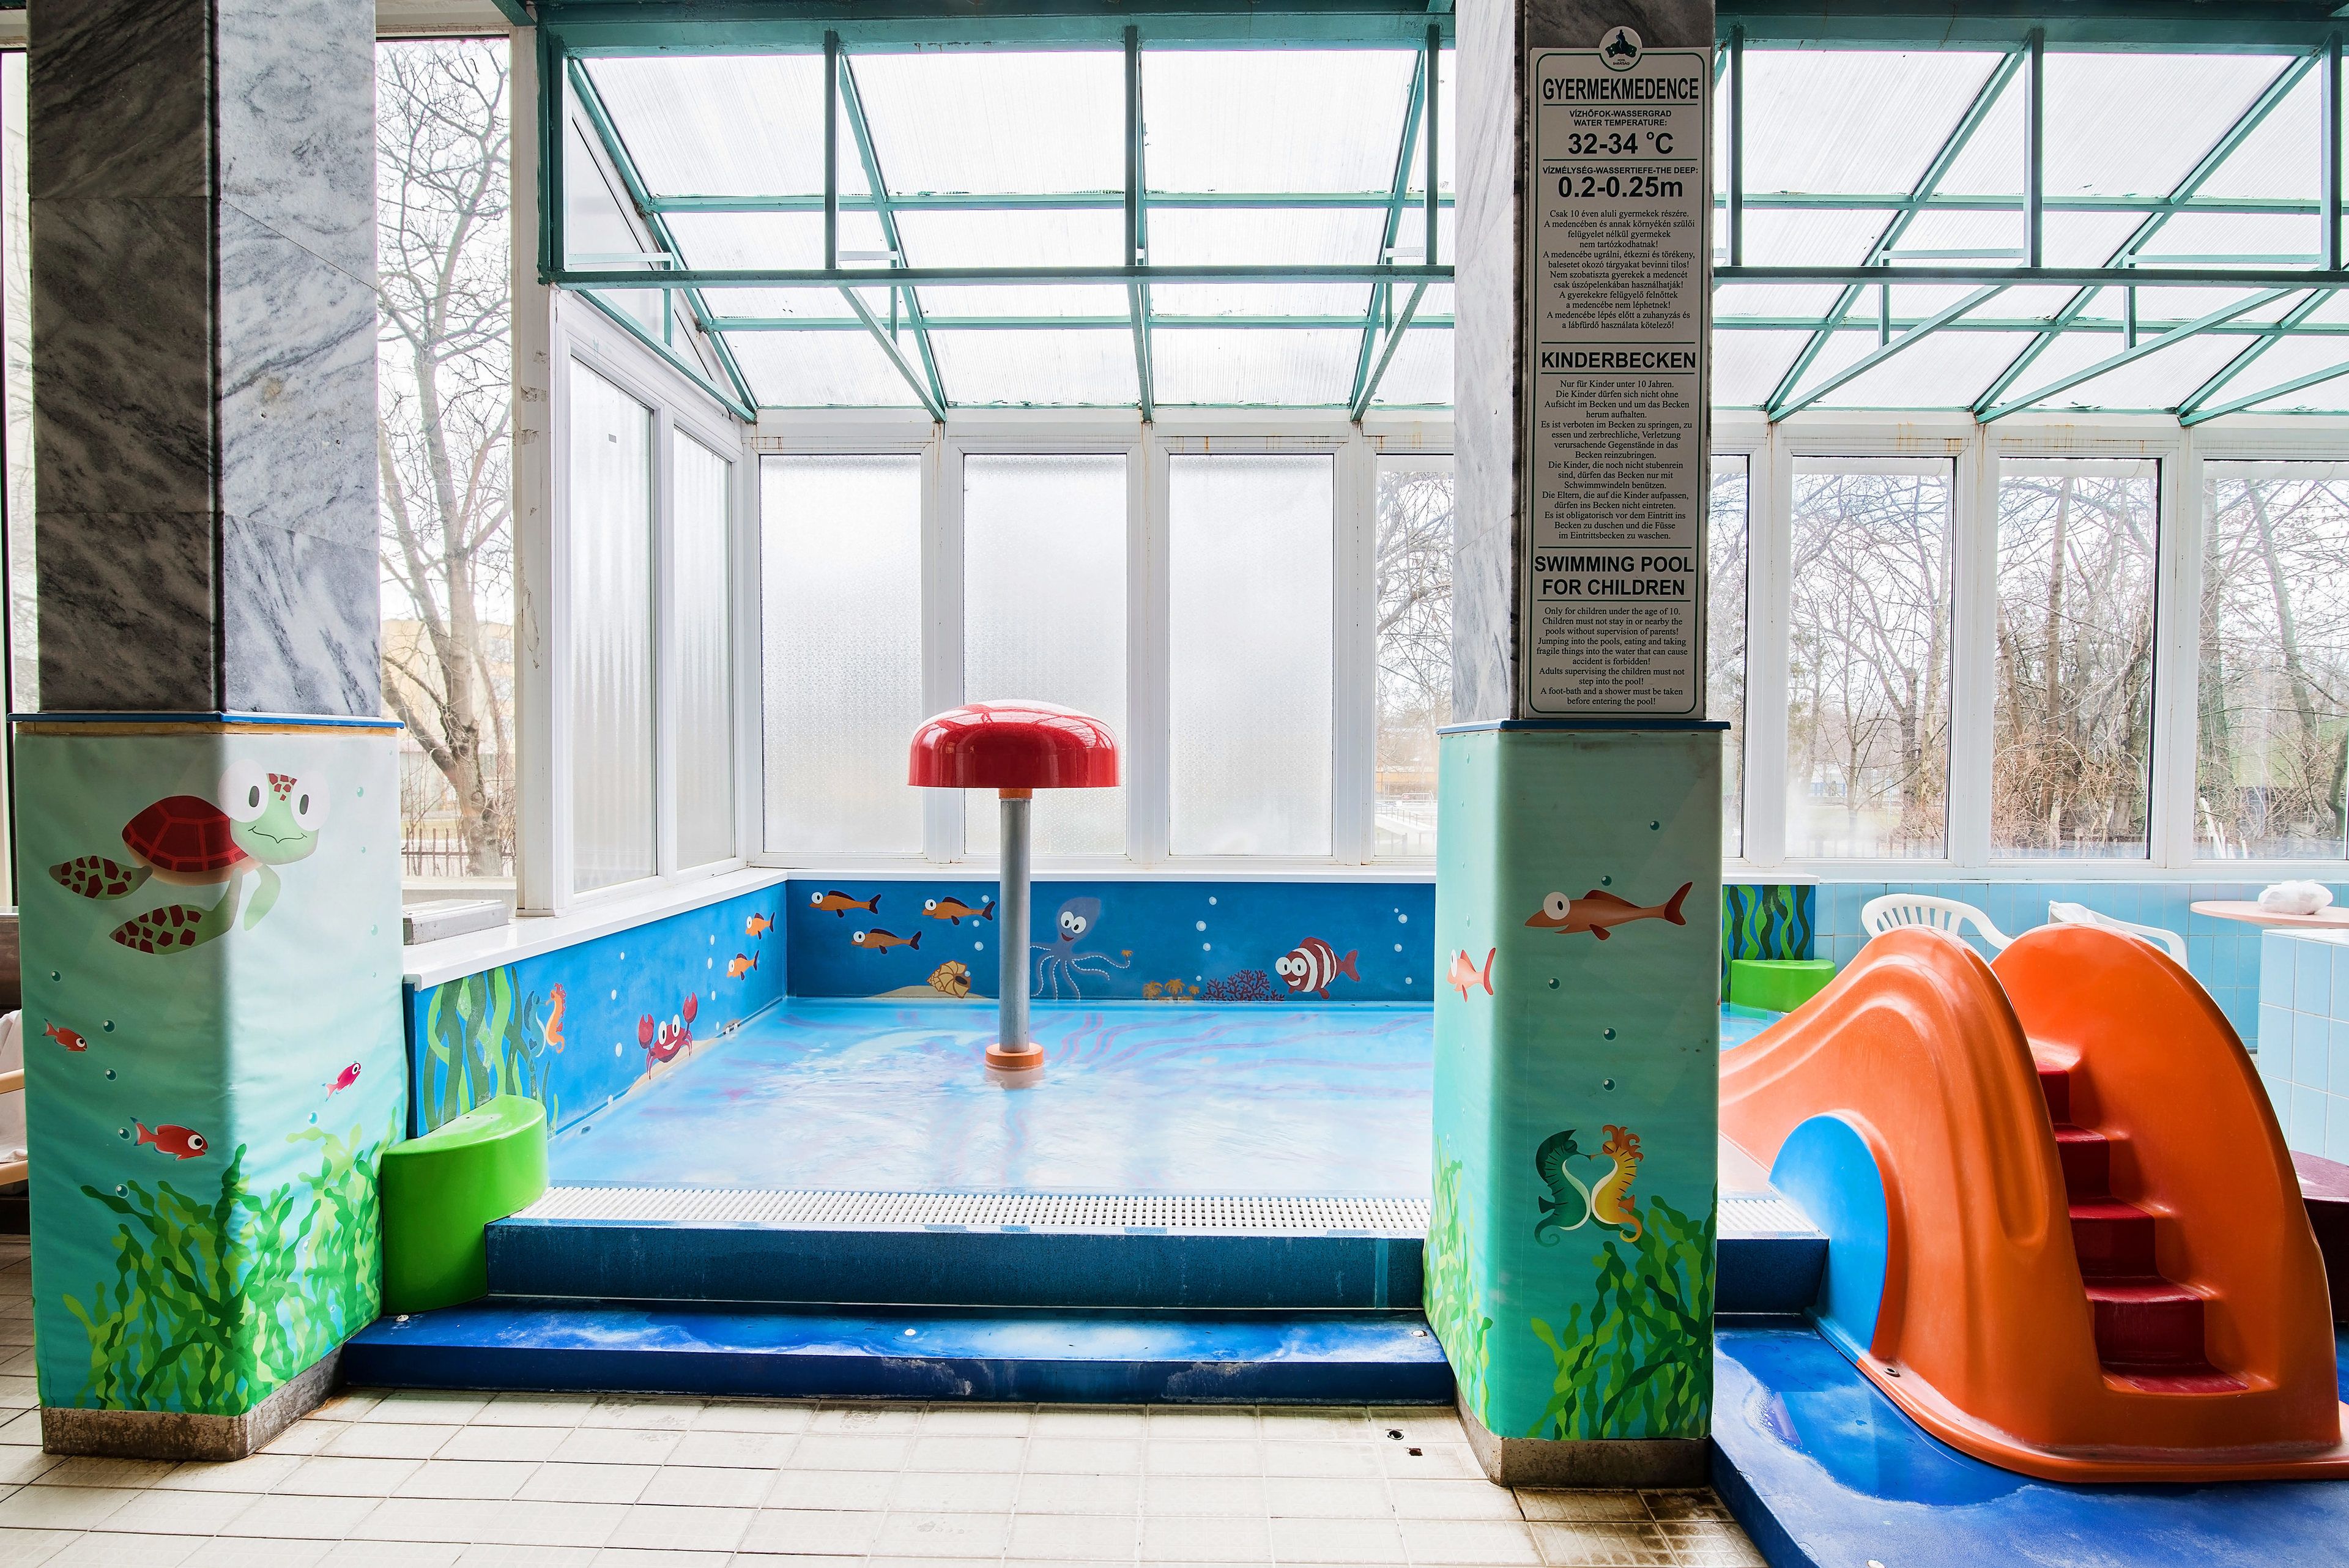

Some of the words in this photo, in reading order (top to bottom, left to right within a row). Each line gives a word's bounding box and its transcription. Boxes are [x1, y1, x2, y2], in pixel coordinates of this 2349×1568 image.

[1543, 78, 1699, 100] GYERMEKMEDENCE
[1570, 109, 1671, 117] VÍZHŐFOK-WASSERGRAD
[1568, 133, 1638, 154] 32-34
[1646, 132, 1673, 154] °C
[1559, 176, 1682, 198] 0.2-0.25m
[1619, 210, 1659, 219] gyermekek
[1568, 230, 1604, 239] felügyelet
[1630, 230, 1671, 239] gyermekek
[1606, 261, 1639, 270] tárgyakat
[1611, 270, 1644, 280] gyerekek
[1572, 281, 1630, 290] úszópelenkában
[1631, 281, 1683, 290] használhatják!
[1567, 291, 1608, 300] gyerekekre
[1610, 291, 1644, 300] felügyelő
[1633, 301, 1670, 310] léphetnek!
[1542, 352, 1696, 368] KINDERBECKEN
[1589, 431, 1639, 439] zerbrechliche,
[1642, 431, 1681, 440] Verletzung
[1608, 441, 1655, 450] Gegenstände
[1604, 451, 1657, 460] reinzubringen.
[1564, 461, 1590, 470] Kinder,
[1558, 471, 1575, 480] sind,
[1534, 556, 1635, 572] SWIMMING
[1641, 556, 1694, 572] POOL
[1543, 579, 1582, 595] FOR
[1587, 579, 1685, 595] CHILDREN
[1545, 607, 1563, 616] Only
[1645, 618, 1669, 626] nearby
[1545, 628, 1565, 636] pools
[1650, 628, 1679, 637] parents!
[1538, 637, 1569, 646] Jumping
[1600, 637, 1622, 647] pools,
[1624, 637, 1646, 647] eating
[1663, 637, 1687, 647] taking
[1565, 667, 1606, 677] supervising
[1625, 678, 1644, 686] pool!
[1637, 697, 1655, 707] pool!
